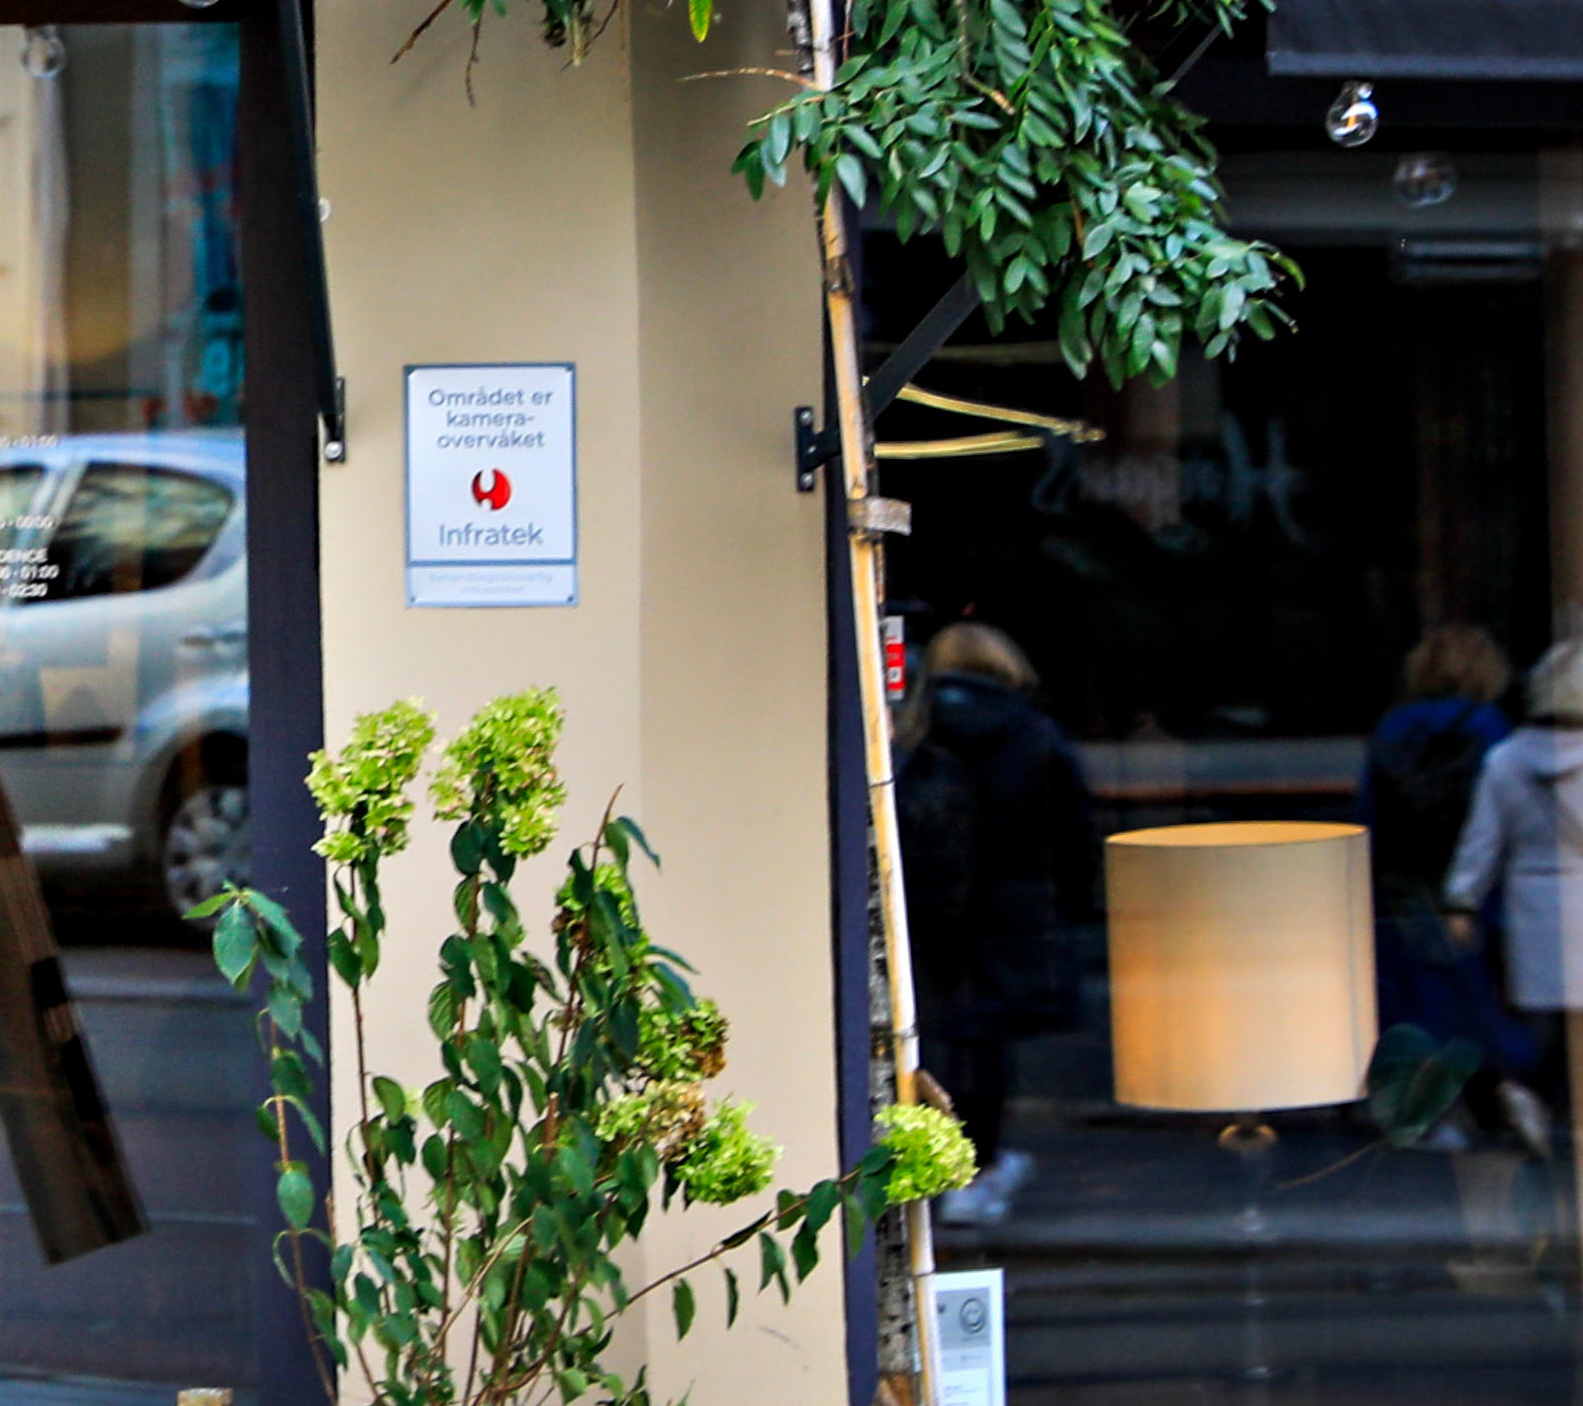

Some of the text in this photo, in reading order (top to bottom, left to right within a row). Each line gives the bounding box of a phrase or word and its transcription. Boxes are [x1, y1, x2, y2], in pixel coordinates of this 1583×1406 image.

[427, 387, 555, 406] Området er
[446, 410, 535, 428] kamera-
[437, 430, 546, 449] overvåket
[439, 521, 544, 546] Infratek
